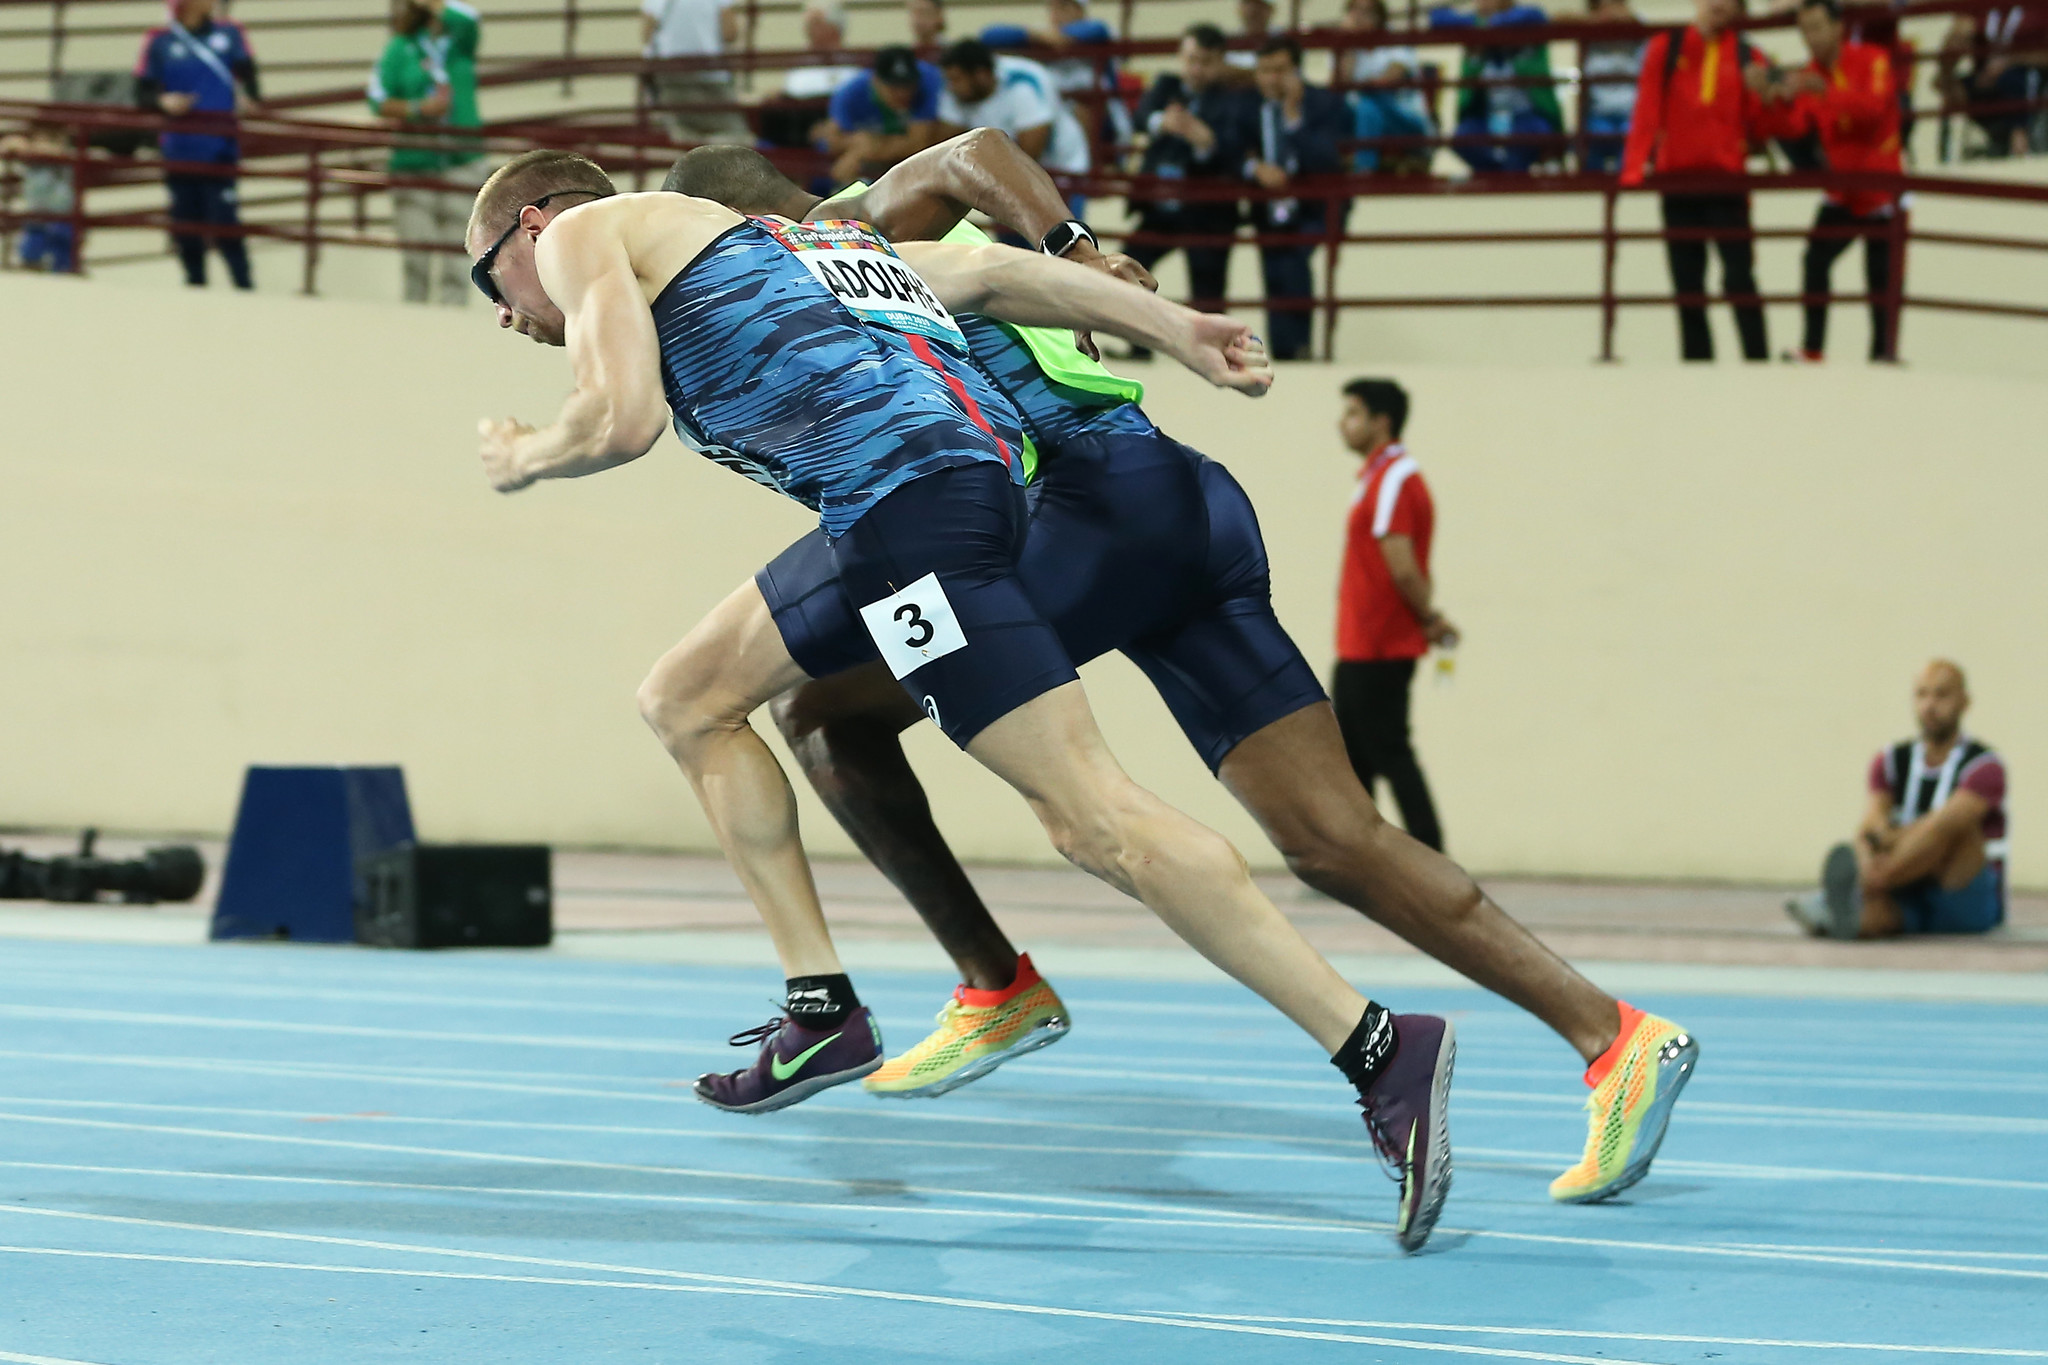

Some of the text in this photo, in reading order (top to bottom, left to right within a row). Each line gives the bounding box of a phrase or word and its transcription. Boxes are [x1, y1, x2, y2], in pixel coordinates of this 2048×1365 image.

[816, 259, 945, 318] ADOLPHE
[884, 312, 931, 327] DUBAI 2019
[893, 603, 934, 648] 3
